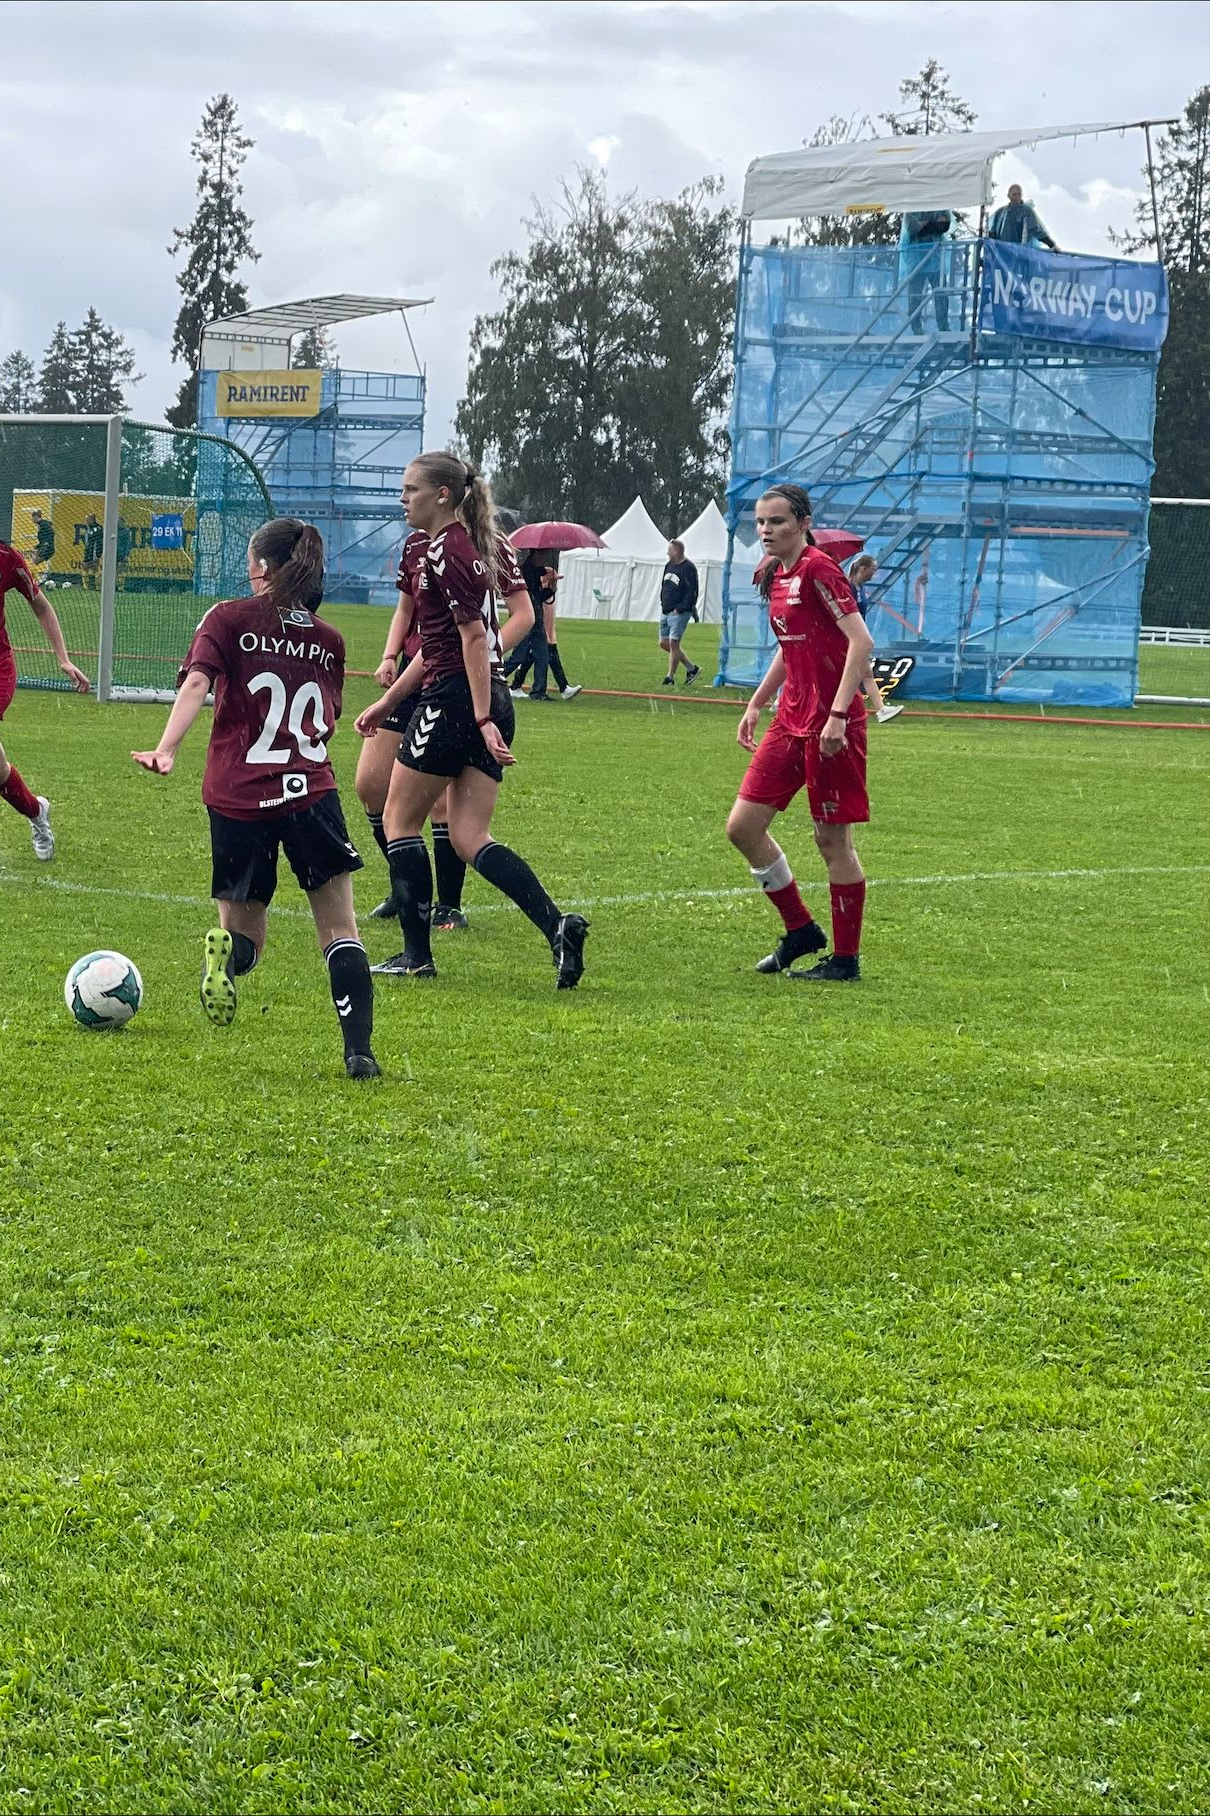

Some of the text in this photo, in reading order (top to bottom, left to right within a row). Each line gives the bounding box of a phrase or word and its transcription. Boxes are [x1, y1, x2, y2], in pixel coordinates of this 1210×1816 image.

[1105, 287, 1157, 325] CUP
[227, 384, 310, 402] RAMIRENT
[152, 526, 183, 537] 29 EK 11
[239, 632, 335, 671] OLYMPIC
[245, 671, 329, 764] 20
